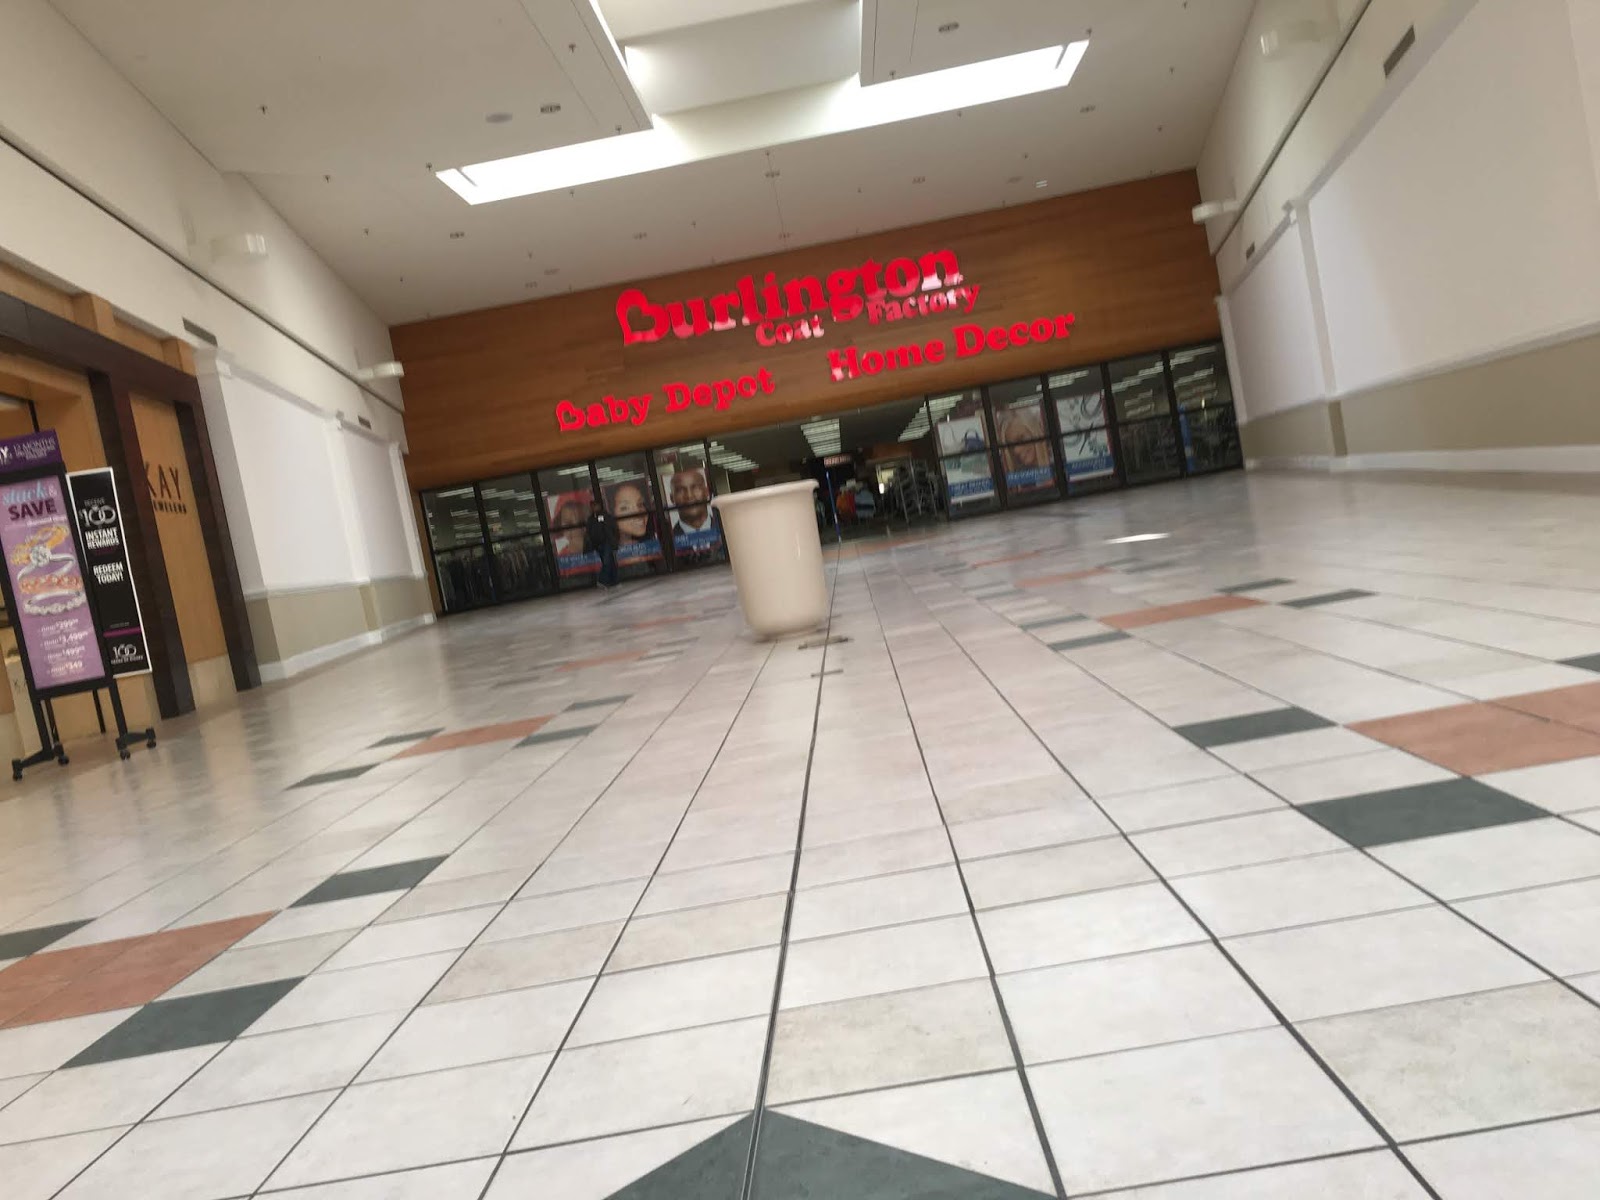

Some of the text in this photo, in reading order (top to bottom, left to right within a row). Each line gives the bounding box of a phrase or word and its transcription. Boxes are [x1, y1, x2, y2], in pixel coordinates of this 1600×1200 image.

[616, 249, 963, 346] Burlington
[755, 284, 980, 347] Coat Factory
[827, 313, 1075, 382] Home Decor
[556, 366, 775, 431] Baby Depot
[144, 461, 181, 500] KAY
[8, 498, 57, 520] SAVE
[85, 527, 118, 540] INSTANT
[87, 536, 119, 549] REWARDS
[93, 561, 123, 575] REDEEM
[96, 571, 123, 584] TODAY!
